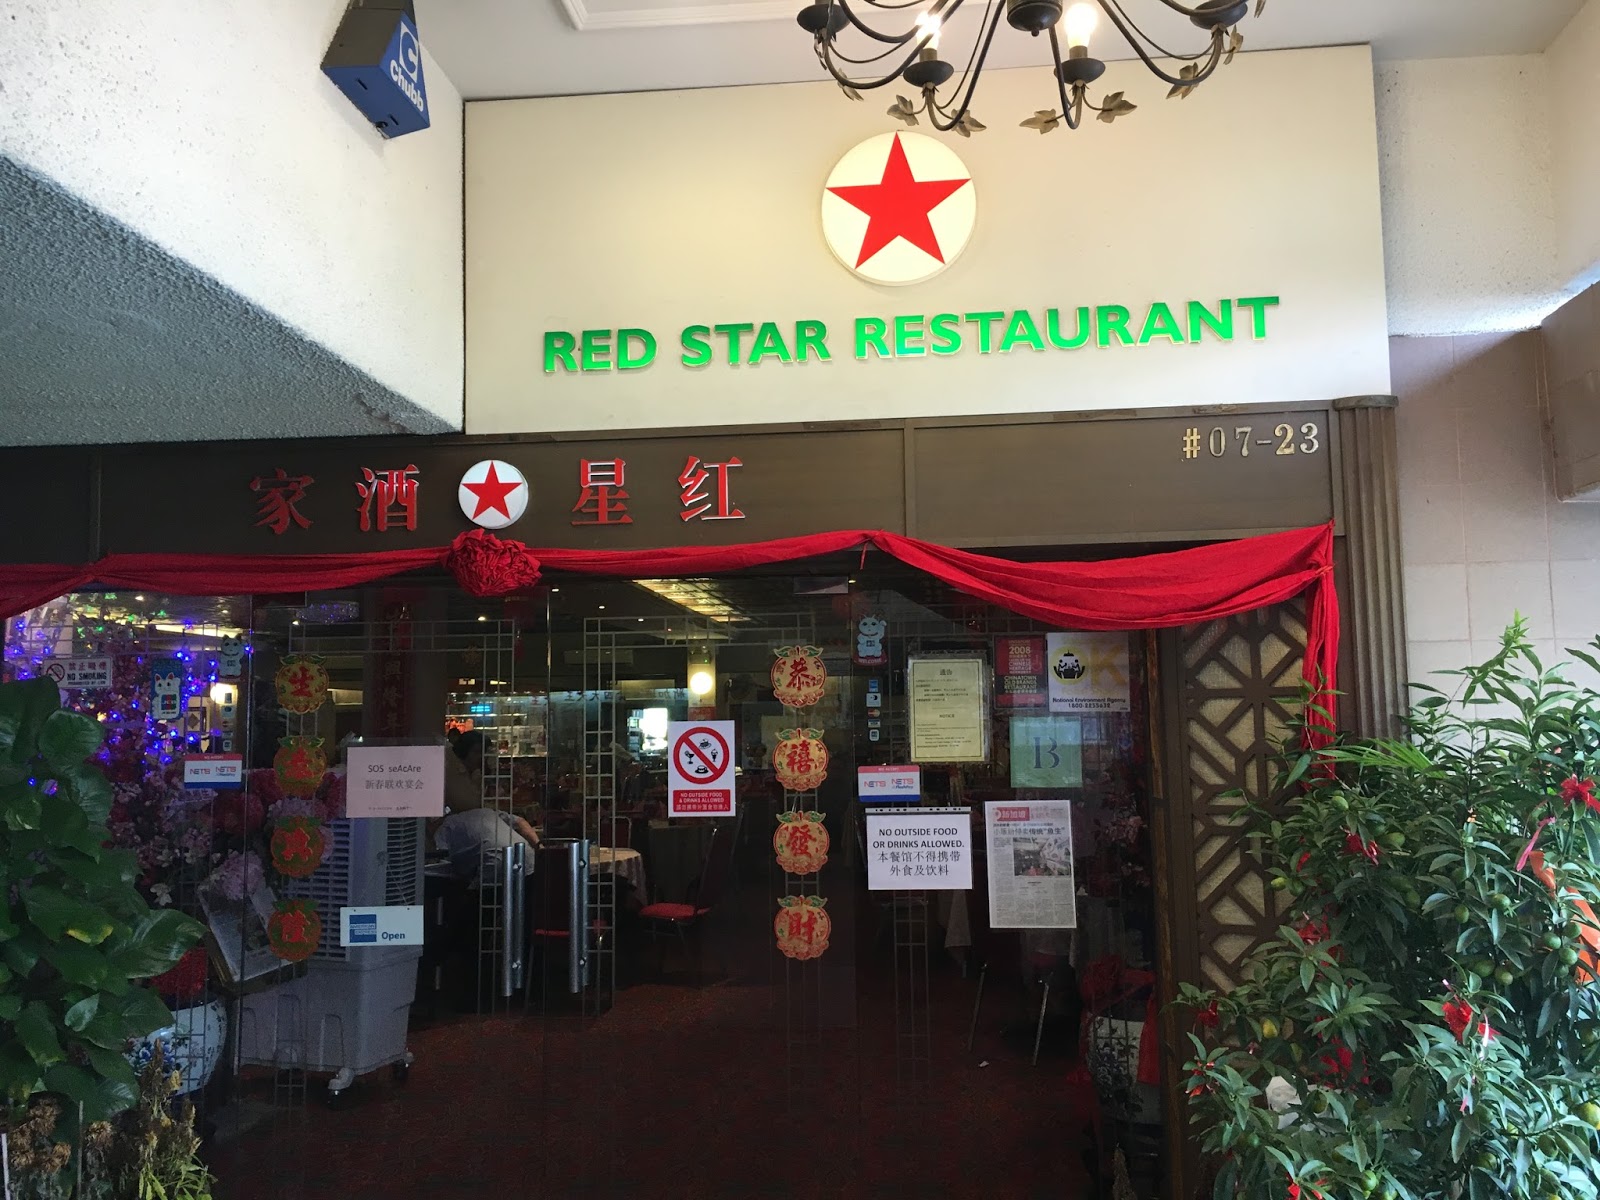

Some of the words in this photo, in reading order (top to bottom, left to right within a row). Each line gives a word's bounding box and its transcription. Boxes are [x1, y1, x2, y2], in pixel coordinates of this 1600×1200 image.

[389, 59, 424, 112] Chubb
[544, 327, 658, 373] RED
[681, 320, 833, 367] STAR
[854, 296, 1280, 360] RESTAURANT
[1182, 422, 1319, 459] #07-23
[1008, 646, 1031, 655] 2008
[67, 672, 76, 681] NO
[79, 671, 107, 681] SMOKING
[1033, 736, 1060, 769] B
[368, 764, 385, 773] SOS
[388, 764, 422, 773] seAcAre
[864, 780, 887, 788] NETS
[879, 828, 892, 837] NO
[894, 828, 931, 837] OUTSIDE
[933, 827, 958, 836] FOOD
[872, 841, 885, 849] OR
[887, 840, 919, 849] DRINKS
[921, 840, 965, 848] ALLOWED.
[878, 850, 961, 863] 本餐馆不得携带
[890, 864, 949, 877] 外食及饮料
[381, 931, 406, 941] Open
